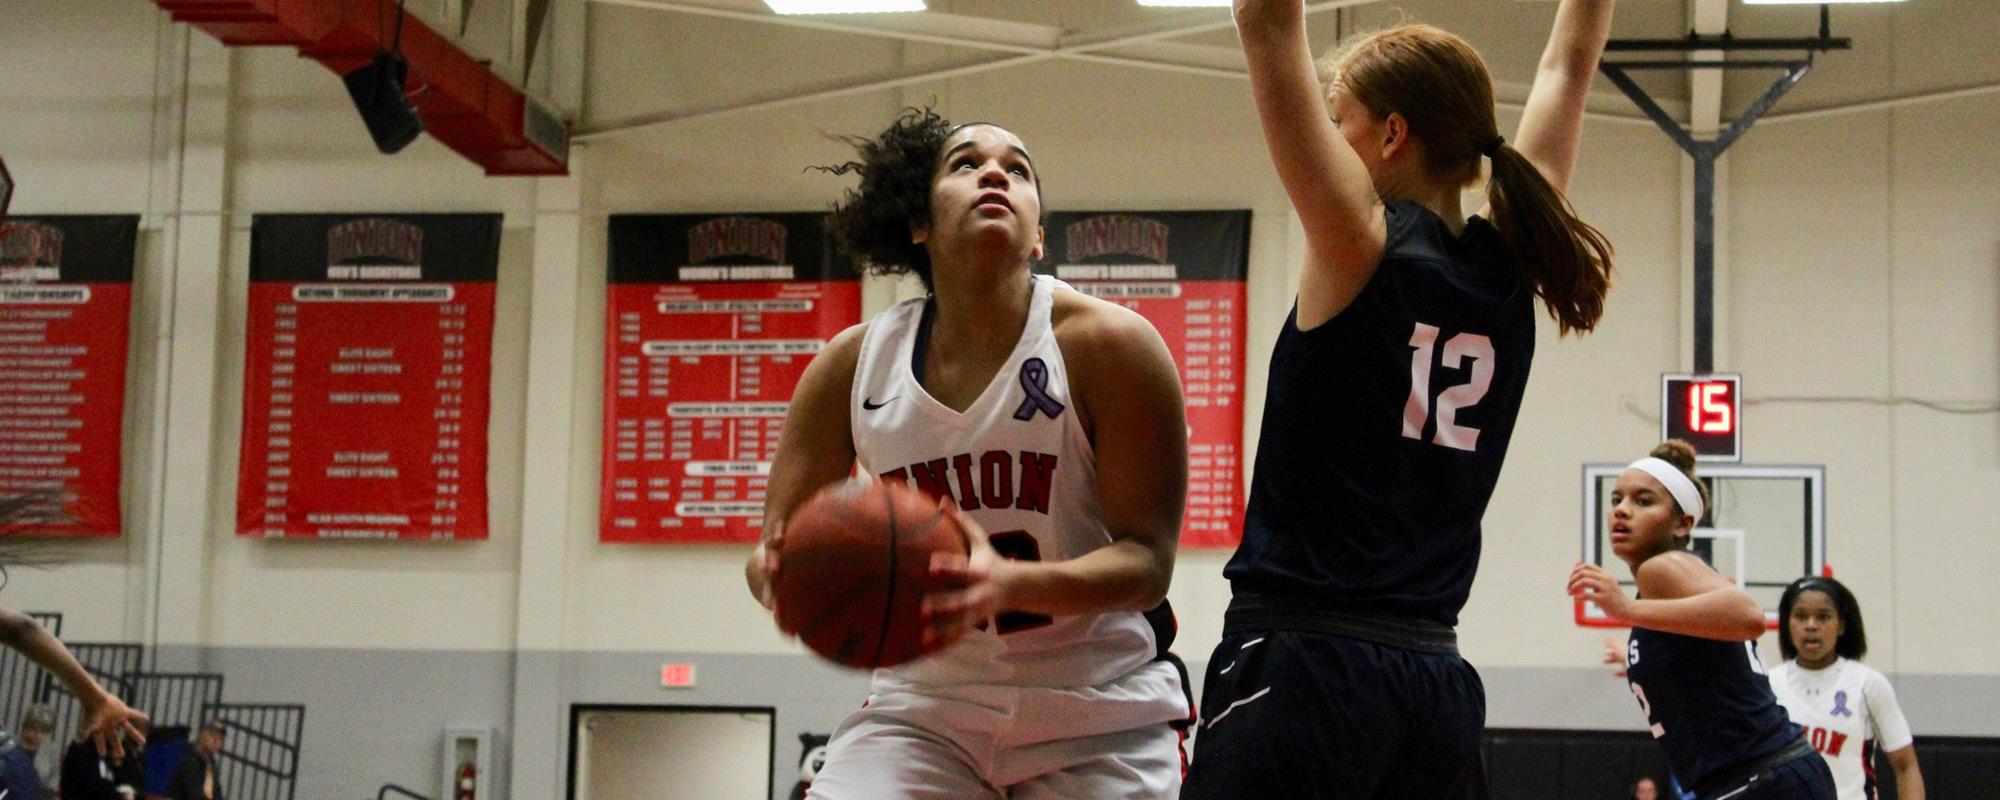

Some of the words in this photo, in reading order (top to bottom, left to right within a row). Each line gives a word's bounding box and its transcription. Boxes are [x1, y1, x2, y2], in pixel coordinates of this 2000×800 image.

[1066, 214, 1169, 264] UNION
[1126, 285, 1174, 297] RANKING
[1402, 321, 1496, 452] 12
[1689, 383, 1731, 432] 15
